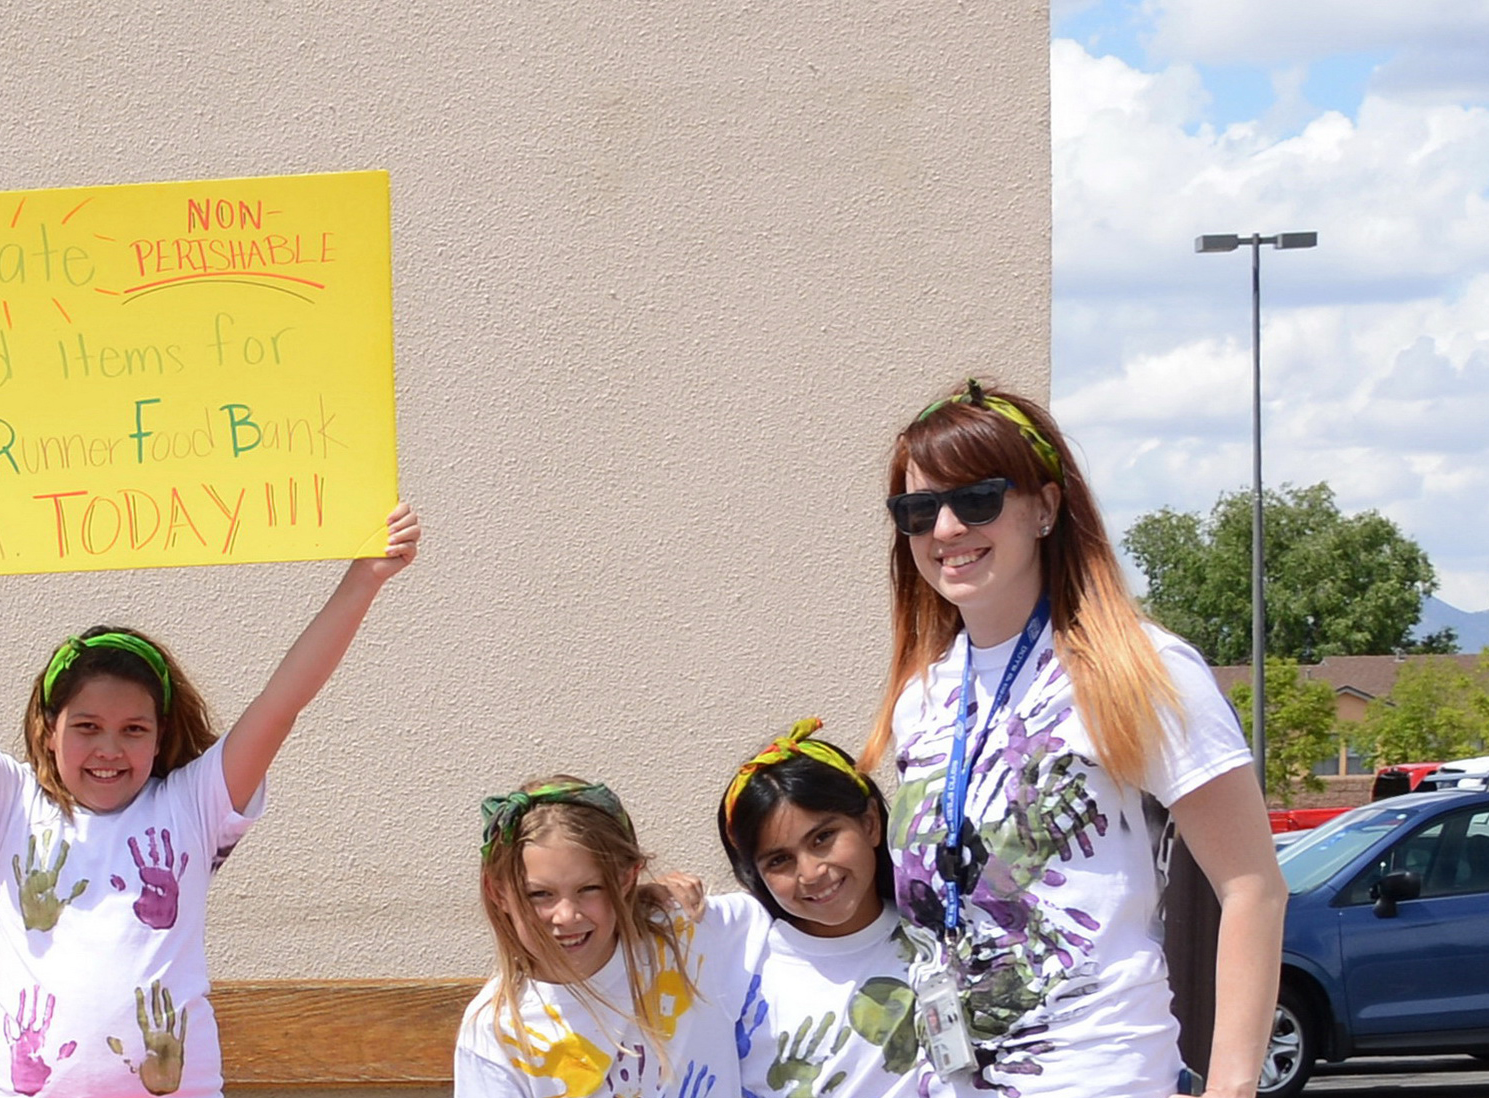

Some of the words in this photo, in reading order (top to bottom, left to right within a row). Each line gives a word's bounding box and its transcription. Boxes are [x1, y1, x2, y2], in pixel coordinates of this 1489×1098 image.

[187, 197, 283, 233] NON-
[129, 231, 336, 277] PERISHABLE
[207, 313, 296, 367] for
[128, 397, 217, 464] Food
[219, 393, 350, 459] Bank
